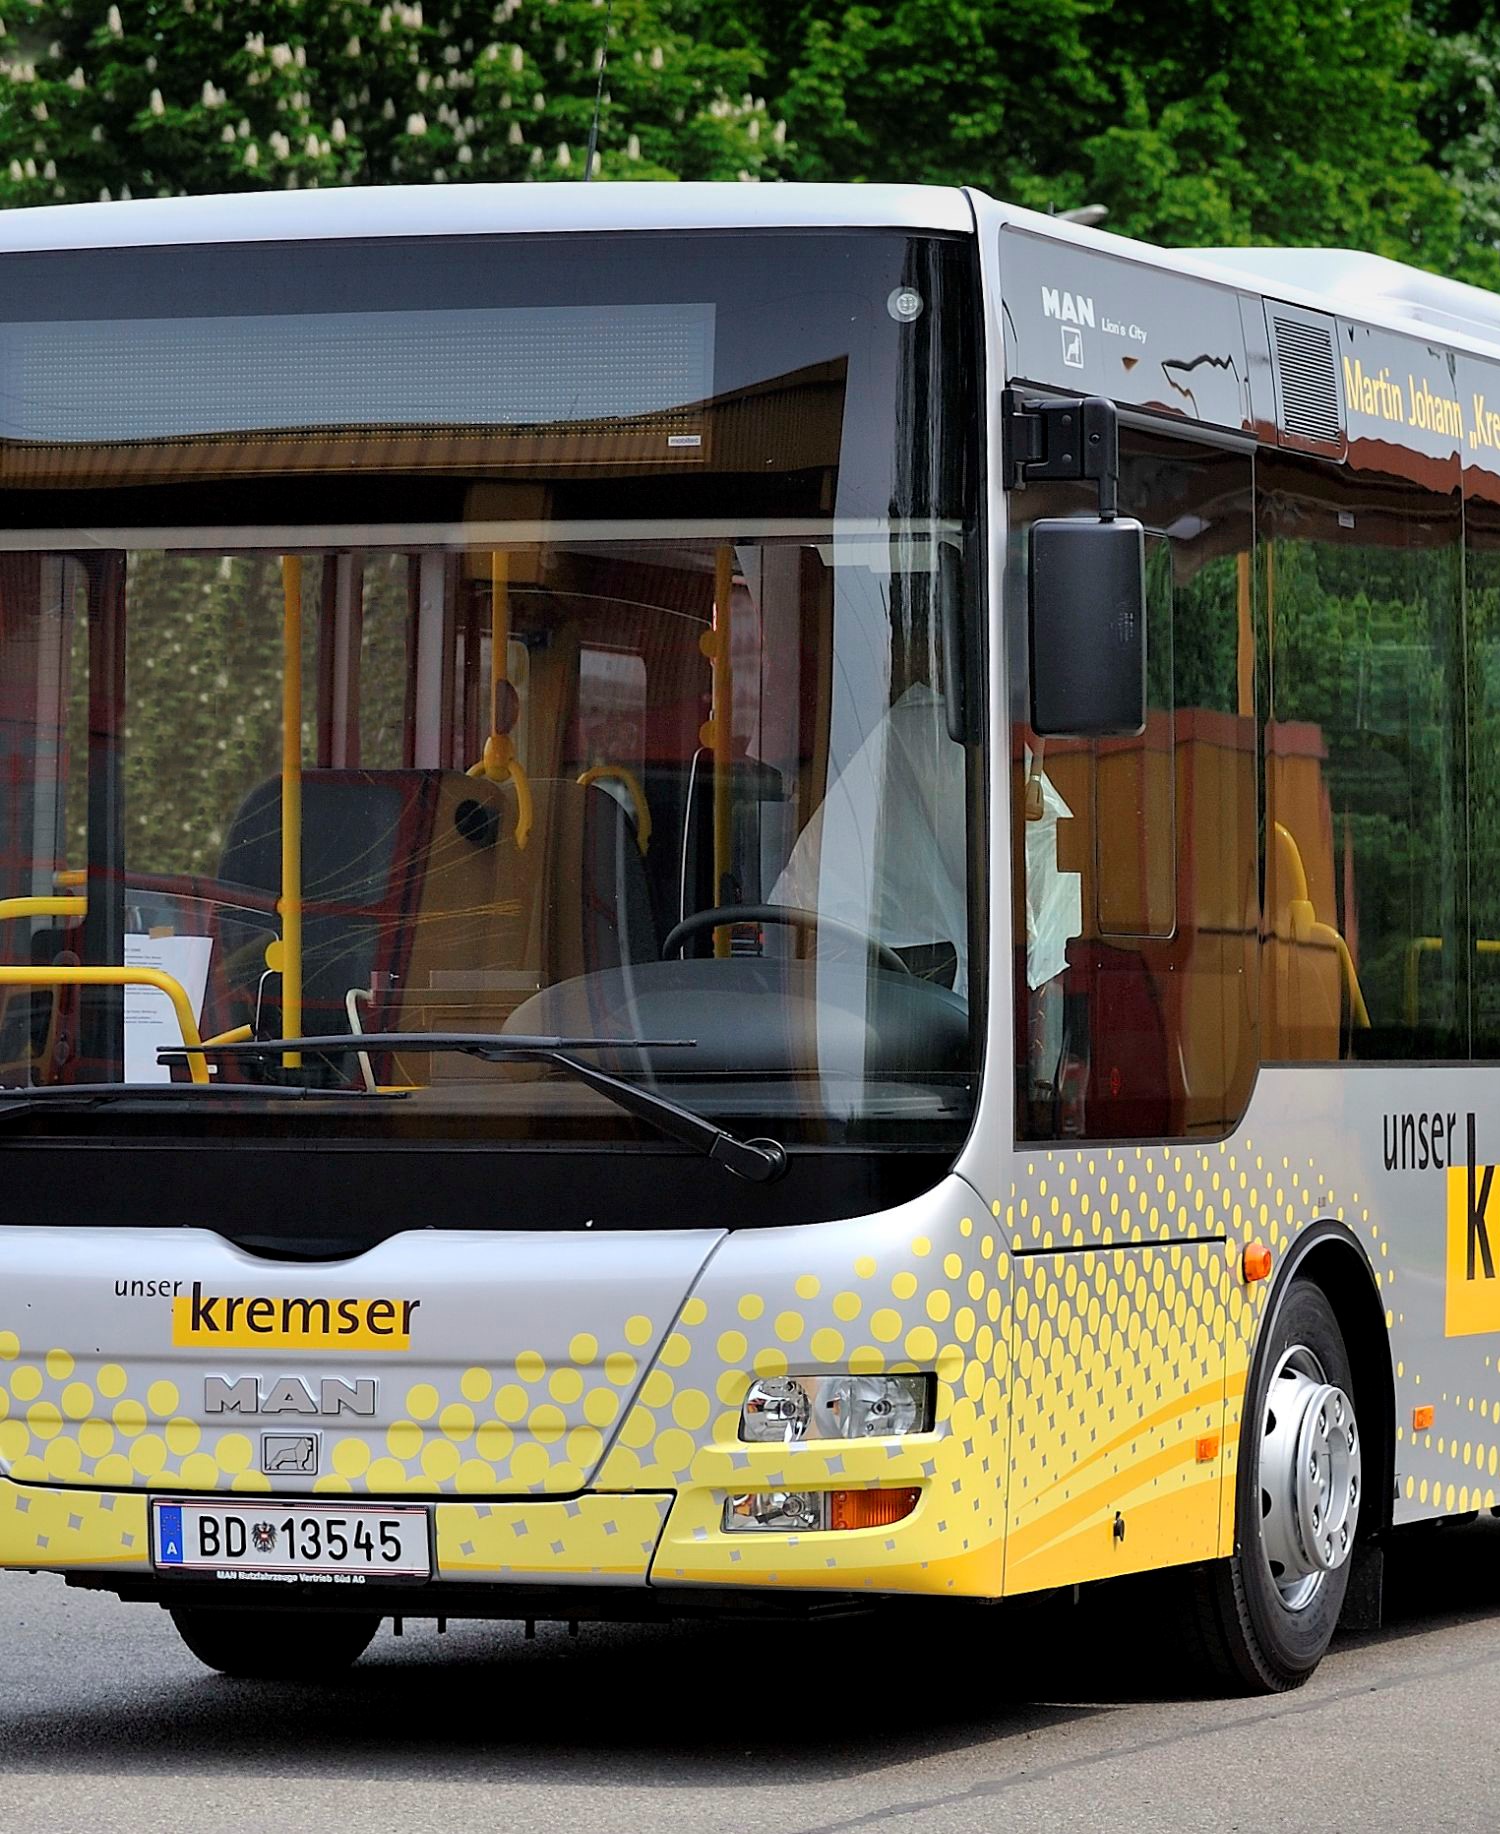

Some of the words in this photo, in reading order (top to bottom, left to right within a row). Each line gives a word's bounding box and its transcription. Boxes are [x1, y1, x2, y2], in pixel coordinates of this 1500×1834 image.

[1041, 285, 1096, 329] MAN
[1101, 317, 1126, 337] Lion's
[1128, 324, 1148, 344] City
[1343, 356, 1404, 422] Martin
[1407, 374, 1464, 439] Johann
[1383, 1111, 1456, 1171] unser
[114, 1280, 183, 1297] unser
[191, 1281, 421, 1335] kremser
[204, 1375, 378, 1416] MAN
[166, 1541, 178, 1555] A
[199, 1515, 247, 1558] BD
[280, 1517, 402, 1562] 13545
[216, 1571, 237, 1580] MAN
[299, 1573, 332, 1583] Vertrieb
[352, 1575, 366, 1584] AG
